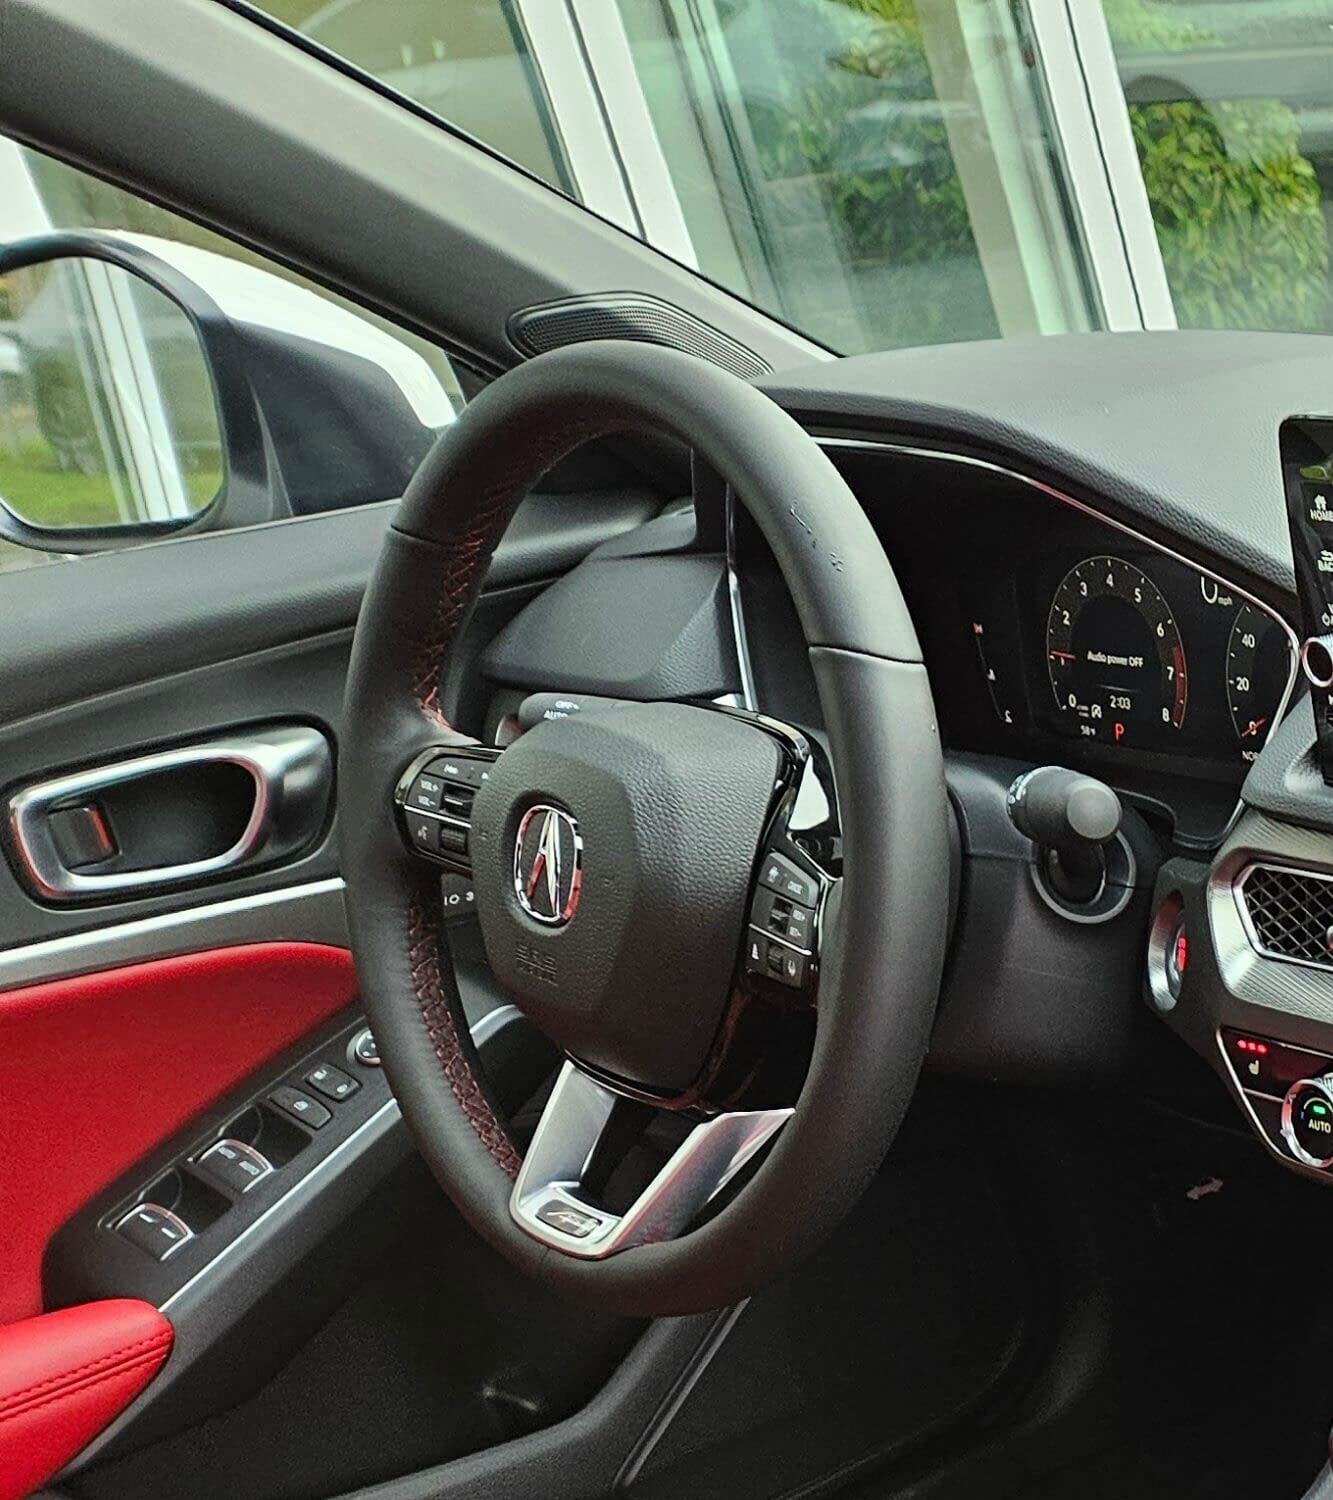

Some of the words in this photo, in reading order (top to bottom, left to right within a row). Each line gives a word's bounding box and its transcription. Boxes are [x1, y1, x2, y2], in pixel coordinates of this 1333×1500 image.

[1105, 573, 1114, 588] 4
[1079, 581, 1089, 597] 3
[1133, 587, 1143, 603] 5
[1062, 610, 1071, 626] 2
[1156, 622, 1165, 638] 6
[1241, 633, 1256, 649] 40
[1166, 665, 1175, 681] 7
[1236, 676, 1250, 692] 20
[1109, 694, 1132, 711] 2:03
[1162, 706, 1170, 722] 8
[1308, 1118, 1332, 1134] AUTO
